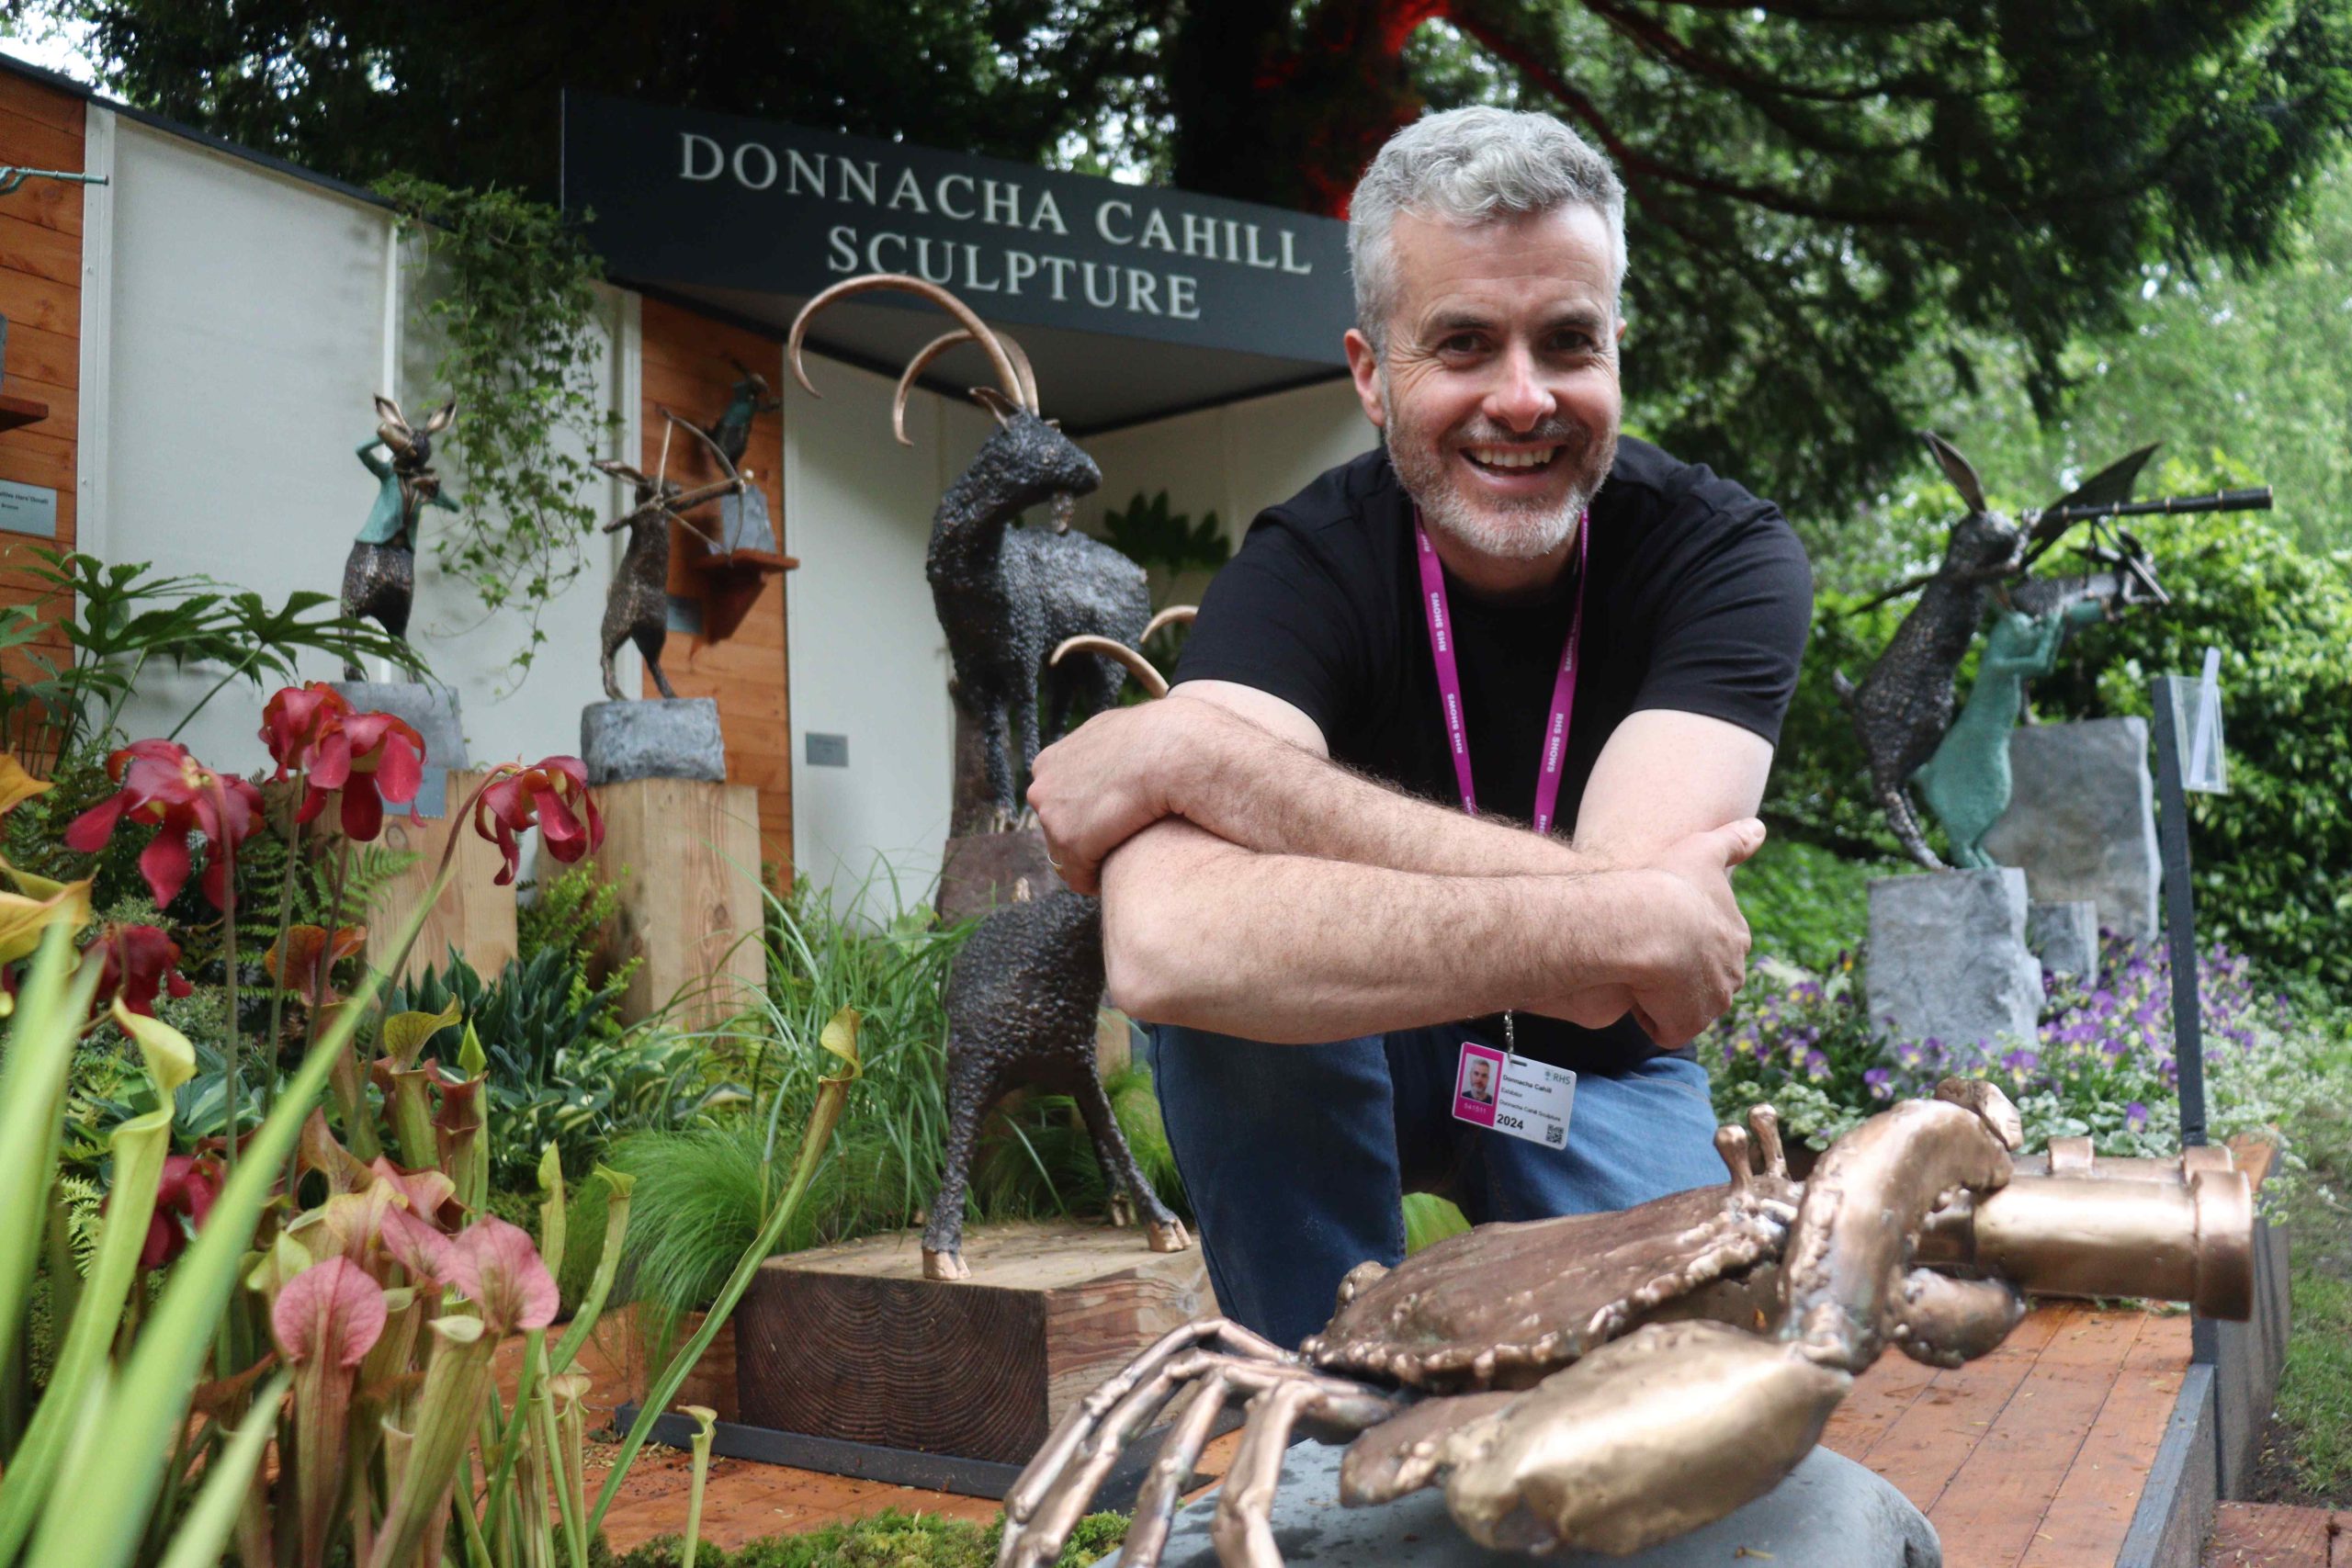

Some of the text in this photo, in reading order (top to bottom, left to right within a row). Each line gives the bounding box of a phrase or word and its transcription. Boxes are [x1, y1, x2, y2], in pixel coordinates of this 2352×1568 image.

[679, 132, 1314, 276] DONNACHA CAHILL
[829, 225, 1202, 321] SCULPTURE
[1430, 592, 1447, 652] RHS SHOWS
[1447, 693, 1464, 754] RHS SHOWS
[1546, 713, 1564, 773] RHS SHOWS
[1534, 1084, 1553, 1093] Cahill
[1553, 1073, 1571, 1085] RHS
[1497, 1113, 1524, 1131] 2024
